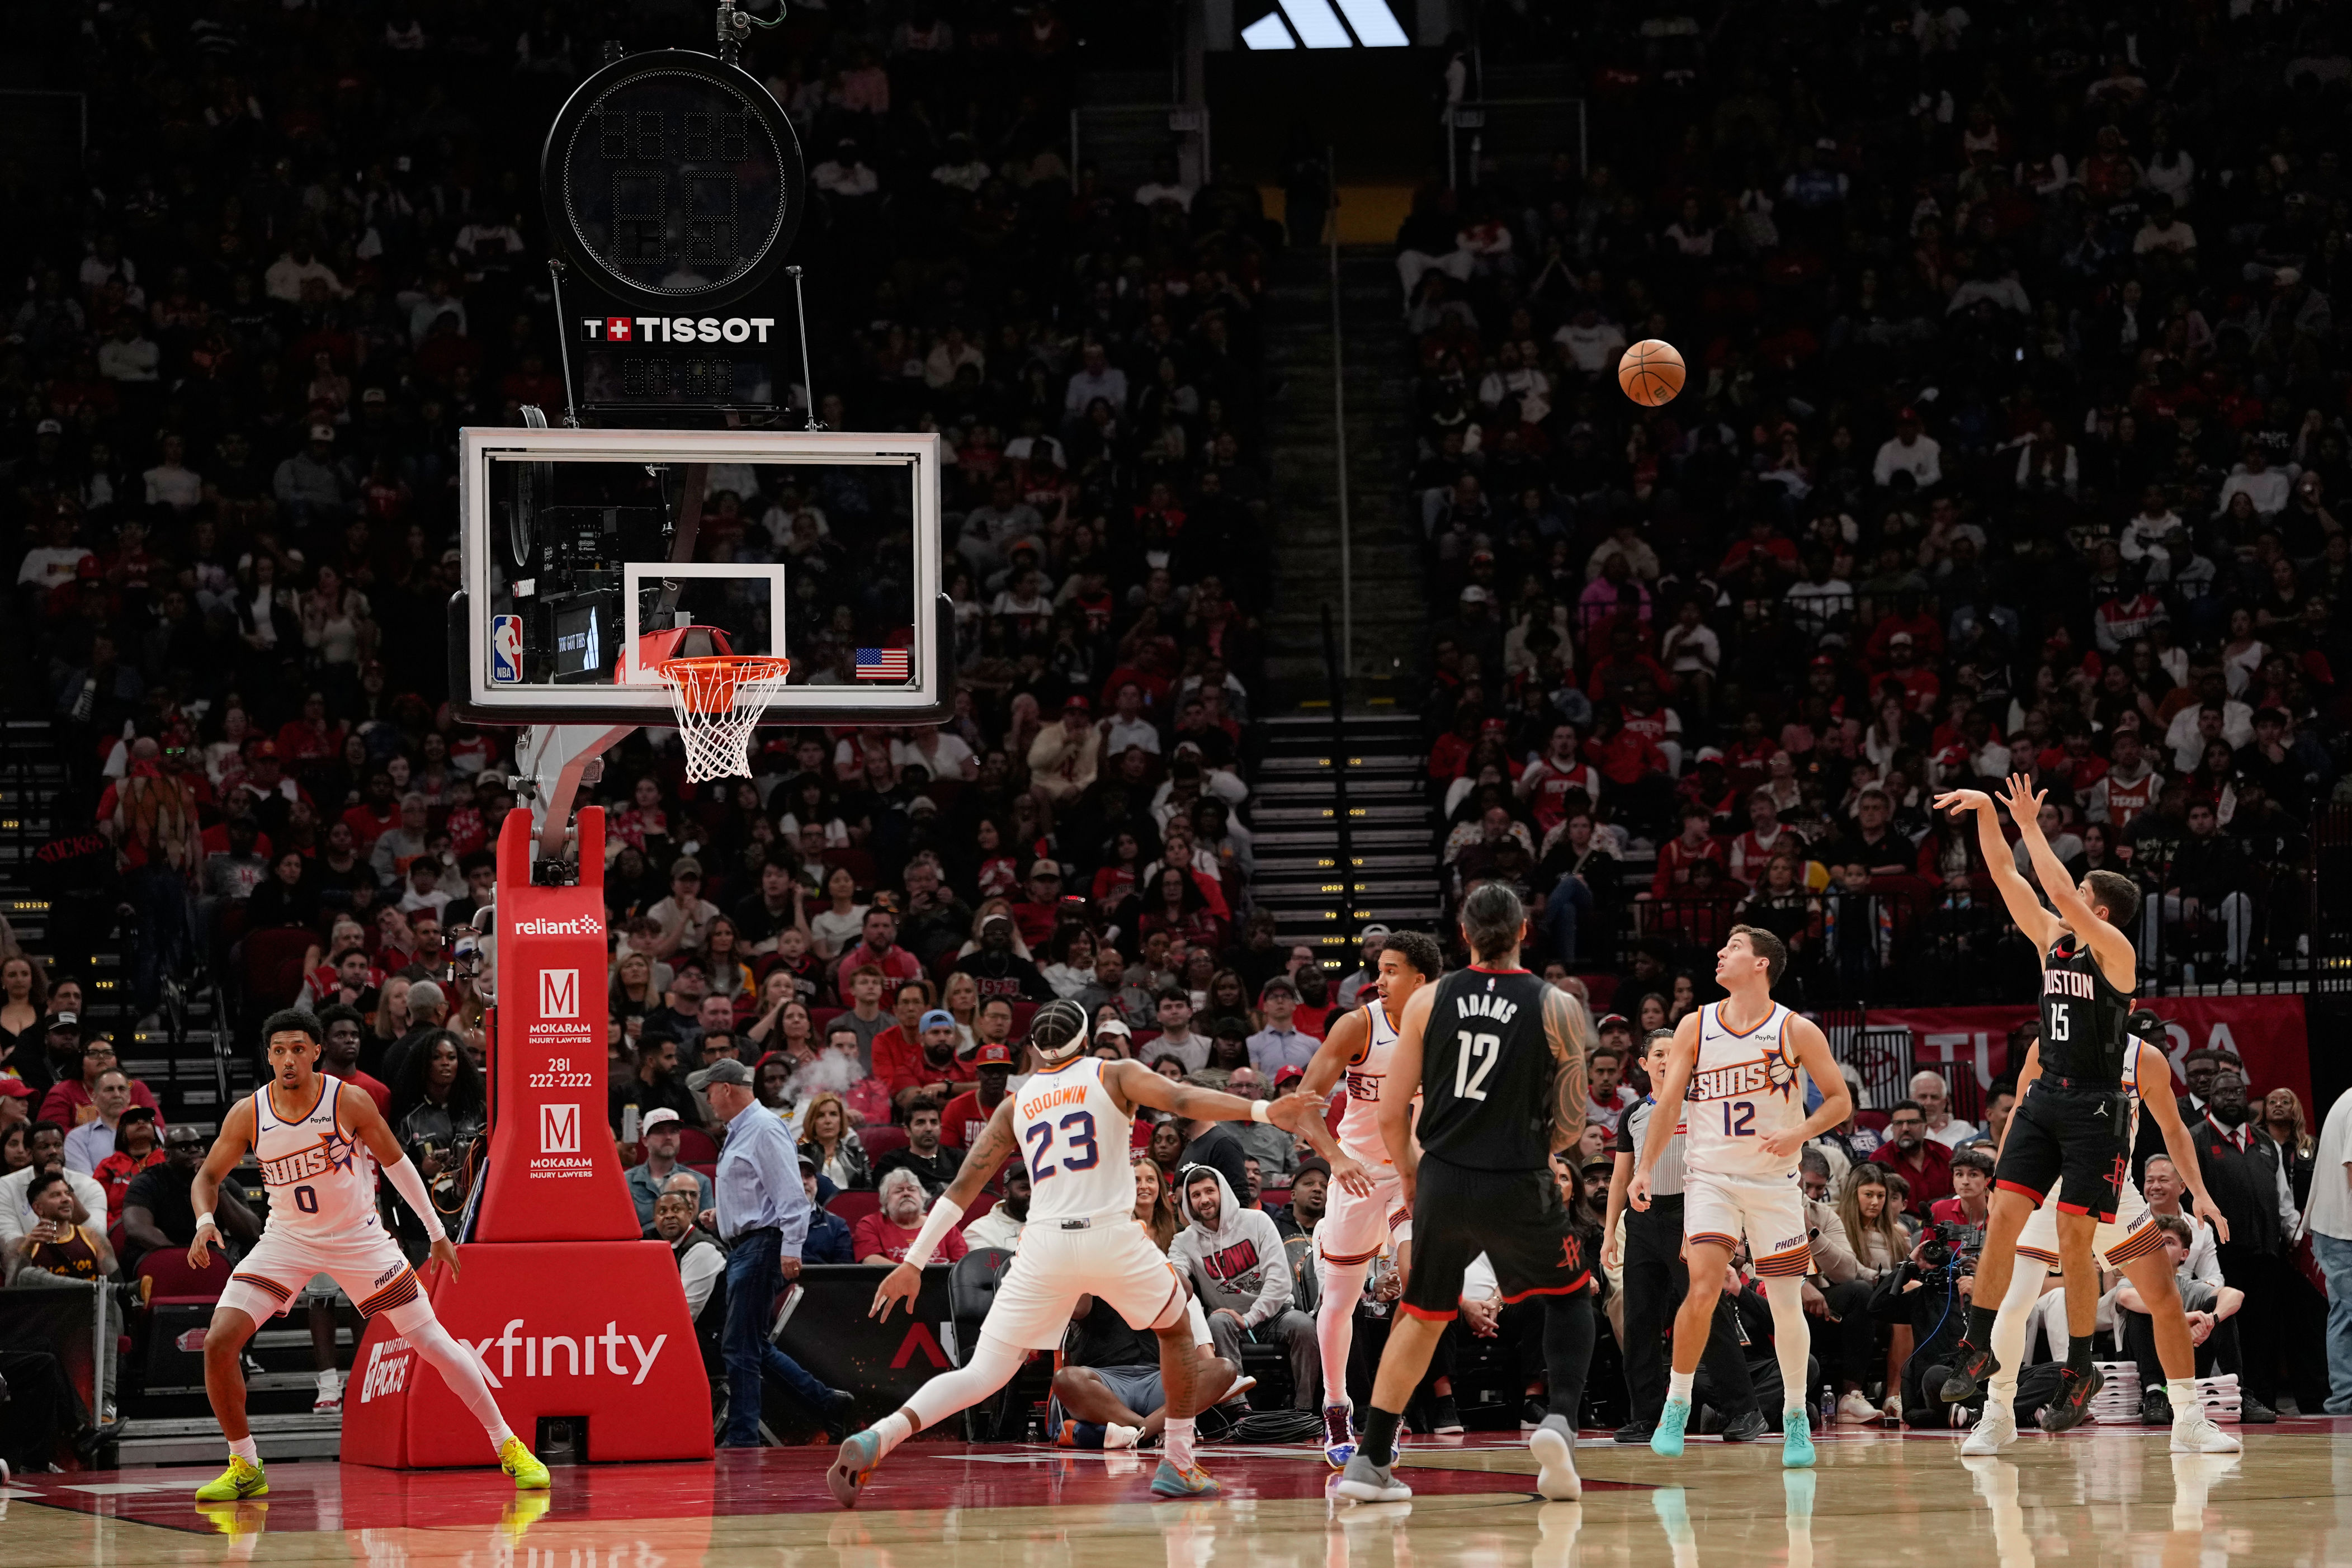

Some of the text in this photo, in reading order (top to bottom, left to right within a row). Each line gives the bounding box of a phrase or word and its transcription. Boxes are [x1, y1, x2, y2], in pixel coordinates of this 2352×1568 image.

[636, 318, 774, 343] TISSOT
[558, 632, 585, 653] YOU GOT THIS
[497, 667, 511, 678] NBA
[516, 918, 580, 936] reliant
[544, 972, 574, 1014] M
[2044, 970, 2094, 1000] OUSTON
[1457, 994, 1518, 1024] ADAMS
[2051, 1003, 2069, 1041] 15
[530, 1023, 591, 1034] MOKARAM
[556, 1035, 591, 1043] LAWYERS
[548, 1058, 570, 1072] 281
[1454, 1029, 1501, 1102] 12
[529, 1073, 592, 1088] 222-2222
[1698, 1062, 1767, 1101] SUNS
[1022, 1085, 1088, 1121] GOODWIN
[545, 1107, 575, 1149] M
[1723, 1102, 1756, 1137] 12
[530, 1158, 592, 1168] MOKARAM
[1026, 1111, 1100, 1186] 23
[263, 1147, 328, 1185] SUNS
[530, 1170, 593, 1179] INJURY LAWYERS
[294, 1186, 319, 1214] 0
[374, 1259, 405, 1289] PHOENIX
[459, 1318, 668, 1388] xfinity
